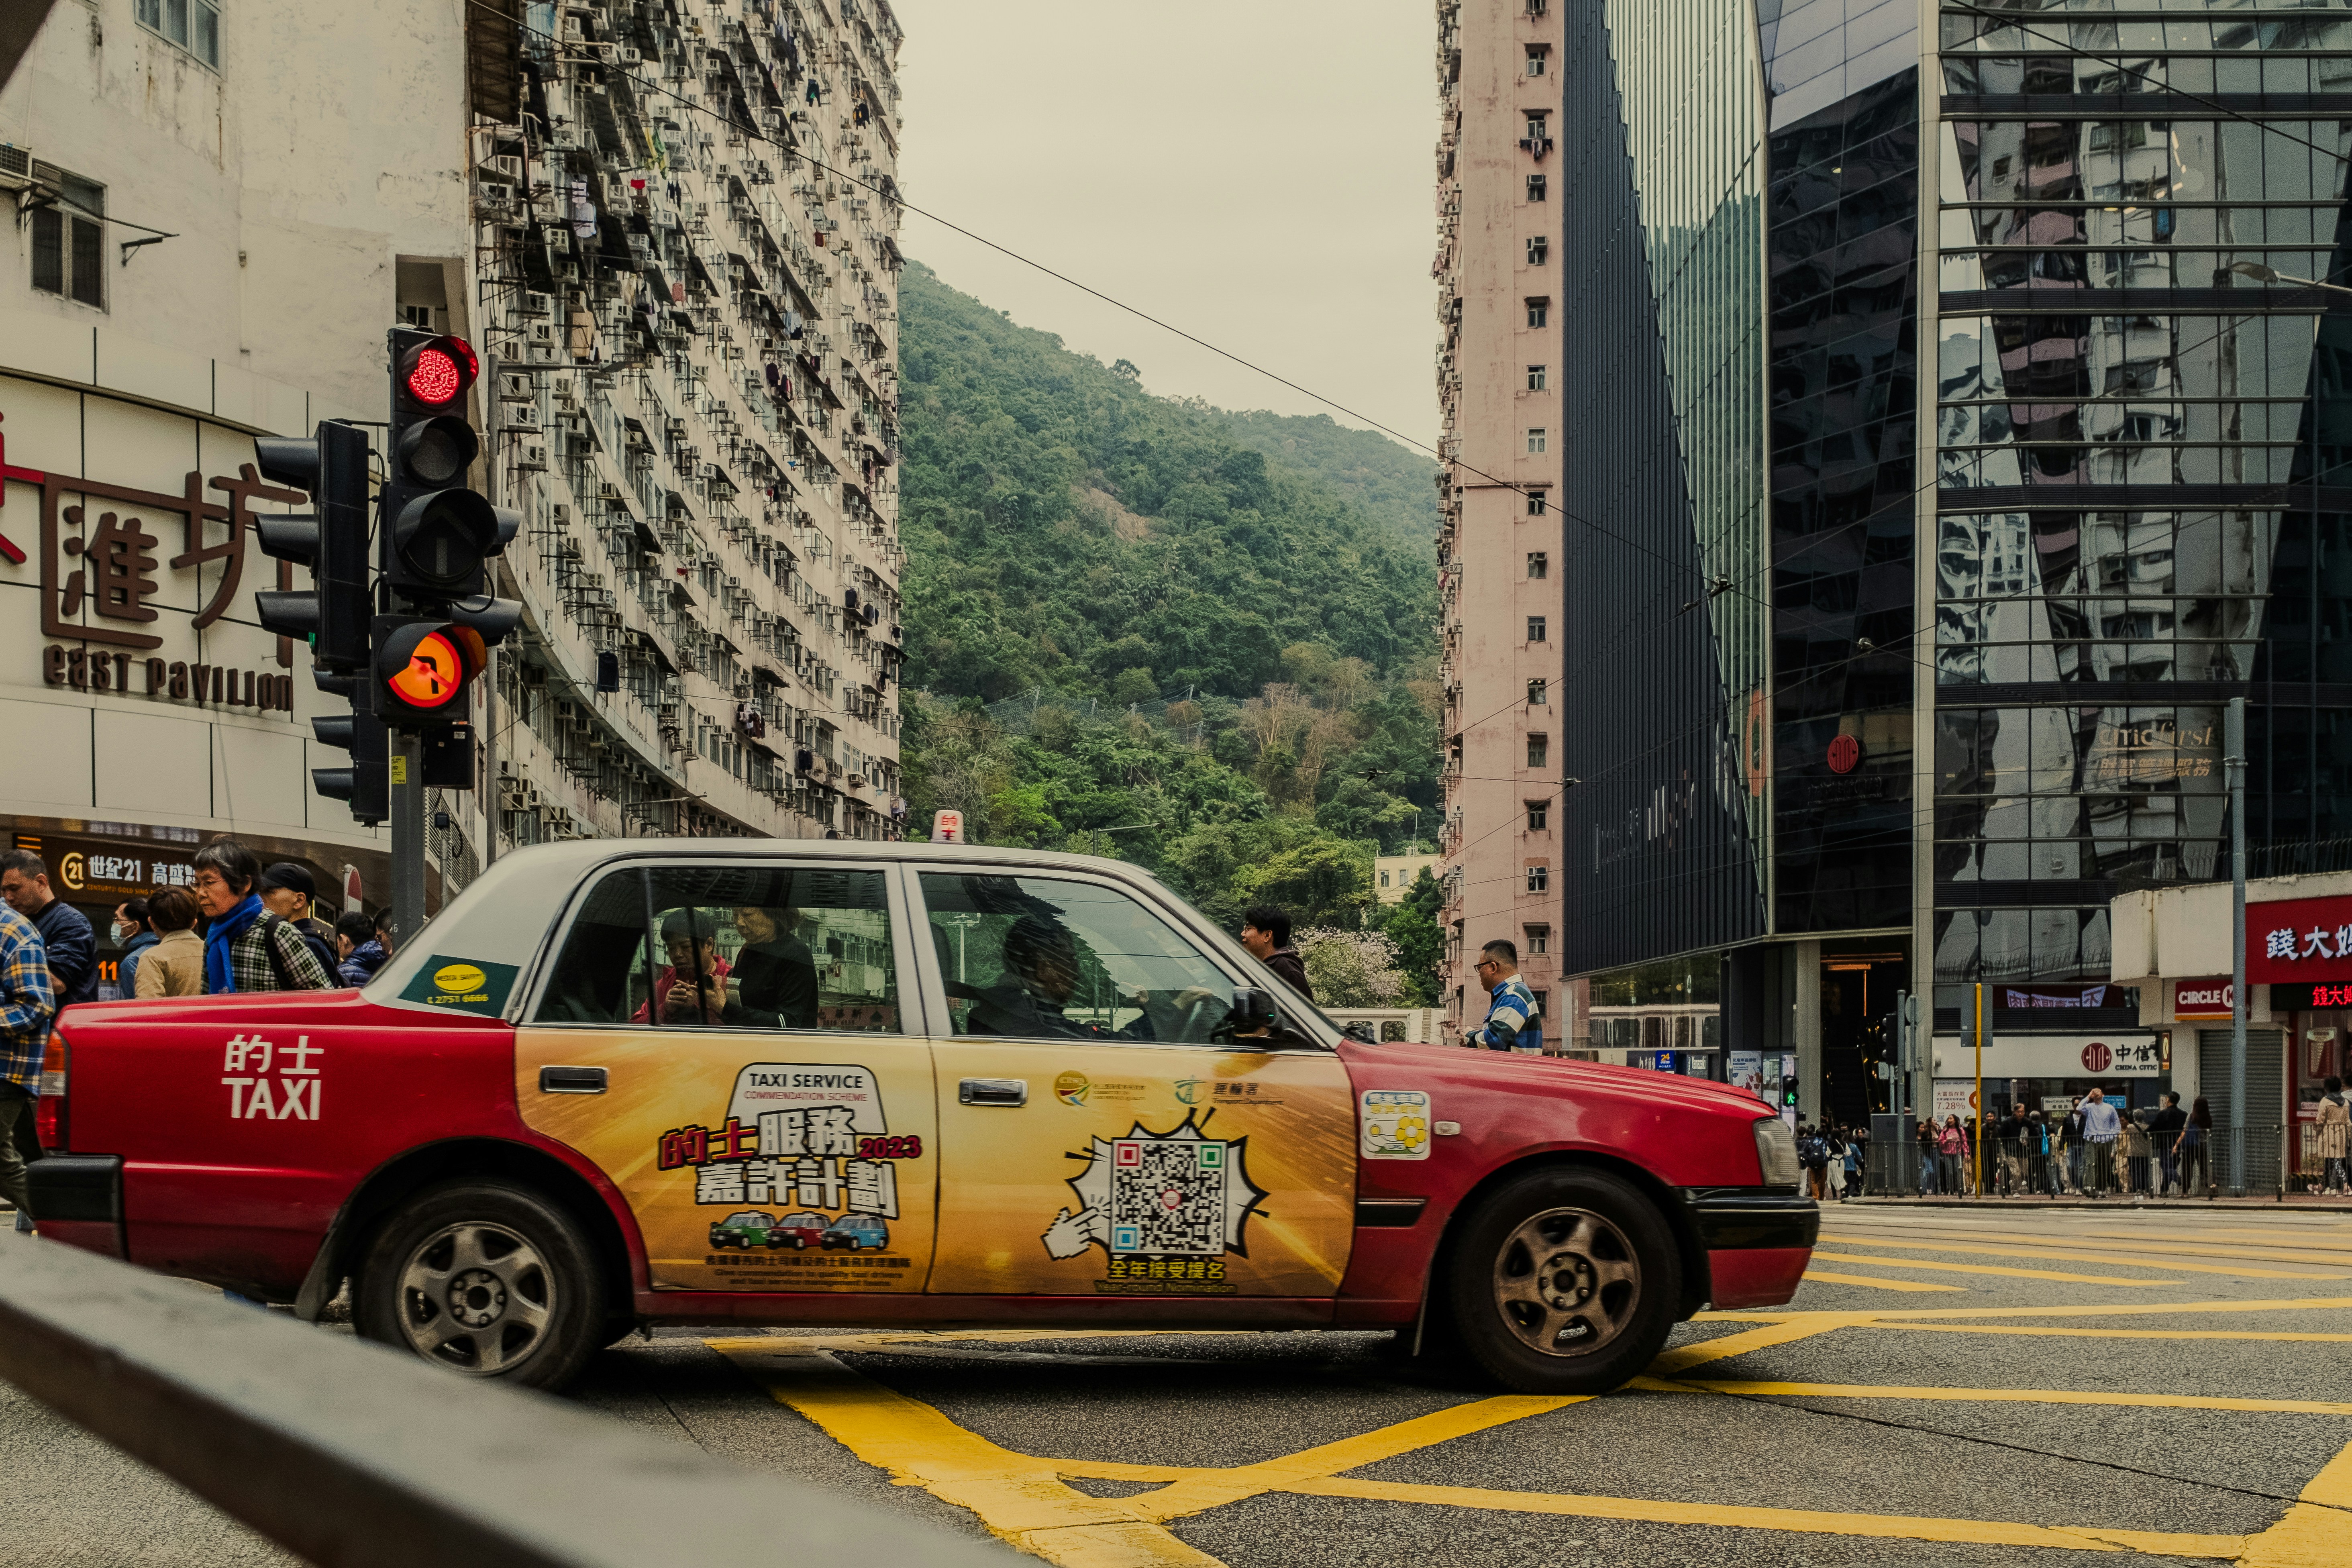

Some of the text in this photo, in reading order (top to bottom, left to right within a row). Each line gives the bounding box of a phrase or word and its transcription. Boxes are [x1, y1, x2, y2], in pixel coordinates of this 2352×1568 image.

[0, 412, 308, 668] 匯坊
[88, 855, 141, 882] 世紀21
[98, 960, 117, 981] 11
[2179, 990, 2221, 1005] CIRCLE
[224, 1034, 324, 1074] 的士
[1661, 1053, 1670, 1061] 24
[749, 1073, 863, 1089] TAXI SERVICE
[222, 1077, 322, 1120] TAXI
[743, 1091, 868, 1101] COMMENDATION SCHEME
[1937, 1102, 1965, 1110] 7.28%
[660, 1107, 922, 1169] 的士服務 2023
[697, 1158, 898, 1219] 嘉許計劃
[1109, 1260, 1224, 1279] 全年接受提名
[1094, 1280, 1237, 1293] Year-round Nomination
